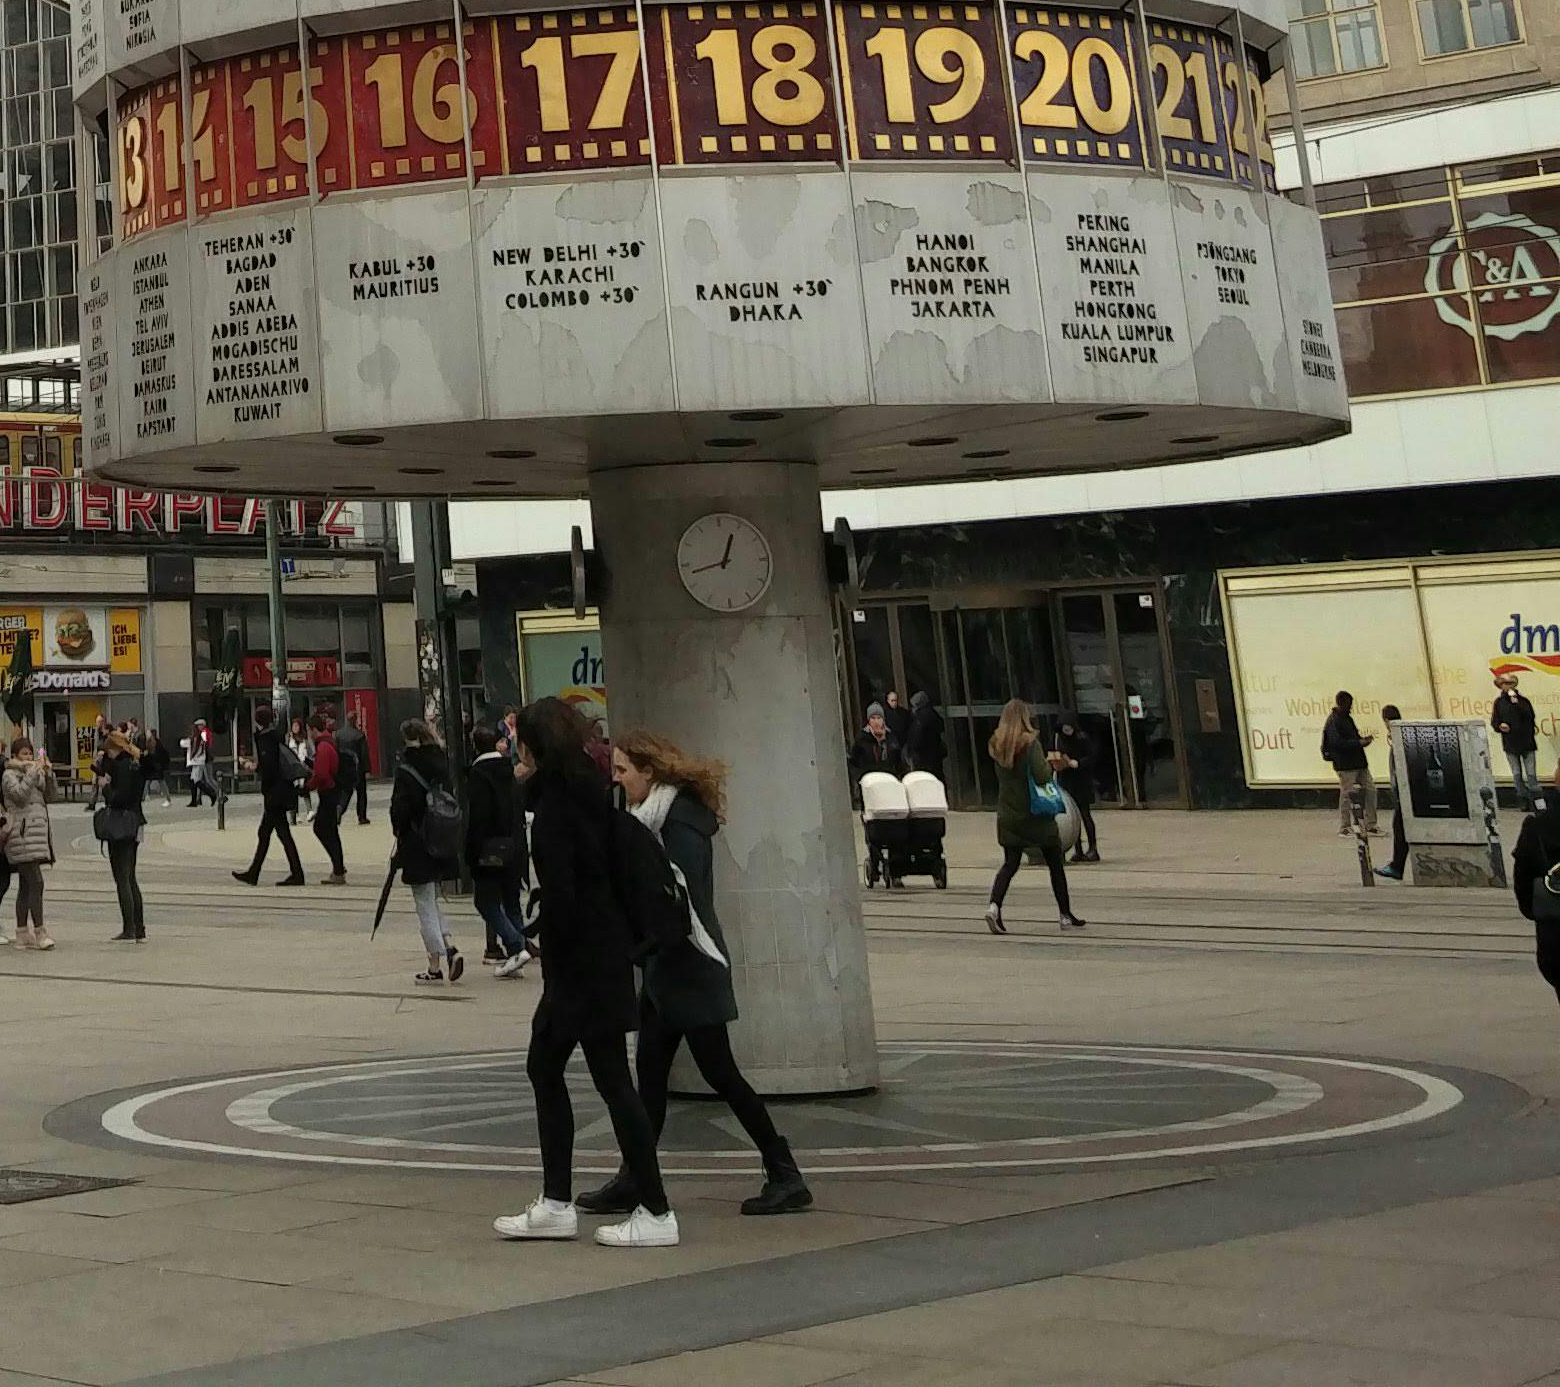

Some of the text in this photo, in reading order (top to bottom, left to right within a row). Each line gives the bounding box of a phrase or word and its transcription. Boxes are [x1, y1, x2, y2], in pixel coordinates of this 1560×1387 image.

[129, 9, 151, 30] SOFIA
[126, 27, 156, 51] NIKOSIA
[520, 30, 641, 132] 17
[695, 24, 826, 126] 18
[865, 26, 986, 125] 19
[1014, 30, 1132, 135] 20
[364, 43, 479, 149] 16
[1149, 43, 1218, 143] 21
[242, 66, 330, 171] 15
[156, 90, 217, 193] 14
[1077, 214, 1130, 232] PEKING
[205, 232, 264, 257] TEHERAN
[916, 234, 974, 251] HANOI
[1065, 235, 1147, 254] SHANGHAI
[133, 251, 168, 275] ANKARA
[226, 252, 277, 275] BAGDAD
[493, 248, 531, 266] NEW
[543, 244, 597, 263] DELHI
[906, 256, 990, 273] BANGKOK
[349, 255, 435, 280] KABUL +30
[525, 266, 614, 286] KARACHI
[1080, 257, 1140, 276] MANILA
[1215, 266, 1245, 284] TOKYO
[1452, 245, 1552, 303] C&A
[133, 272, 169, 295] ISTANBUL
[235, 274, 270, 295] ADEN
[353, 277, 439, 301] MAURITIUS
[696, 282, 779, 301] RANGUN
[890, 278, 1011, 295] PHNOM PENH
[1090, 280, 1135, 298] PERTH
[139, 293, 164, 314] ATHEN
[229, 295, 276, 316] SANAA
[505, 289, 590, 310] COLOMBO
[1218, 287, 1250, 306] SEOUL
[729, 303, 803, 323] DHAKA
[911, 301, 995, 318] JAKARTA
[1075, 301, 1156, 319] HONGKONG
[135, 318, 149, 335] TEL
[211, 314, 298, 340] ADDIS ABEBA
[1060, 322, 1175, 343] KUALA LUMPUR
[131, 332, 175, 357] JERUSALEM
[212, 335, 298, 361] MOGADISCHU
[1083, 346, 1159, 364] SINGAPUR
[141, 355, 166, 376] BEIRUT
[213, 357, 300, 382] DARESSALAM
[134, 374, 176, 397] DAMASKUS
[206, 377, 309, 405] ANTANANARIVO
[143, 397, 167, 416] KAIRO
[234, 402, 282, 423] KUWAIT
[137, 417, 175, 438] KAPSTADT
[112, 625, 127, 635] ICH
[113, 635, 137, 645] LIEBE
[1500, 614, 1560, 654] dm
[1252, 728, 1295, 750] Duft
